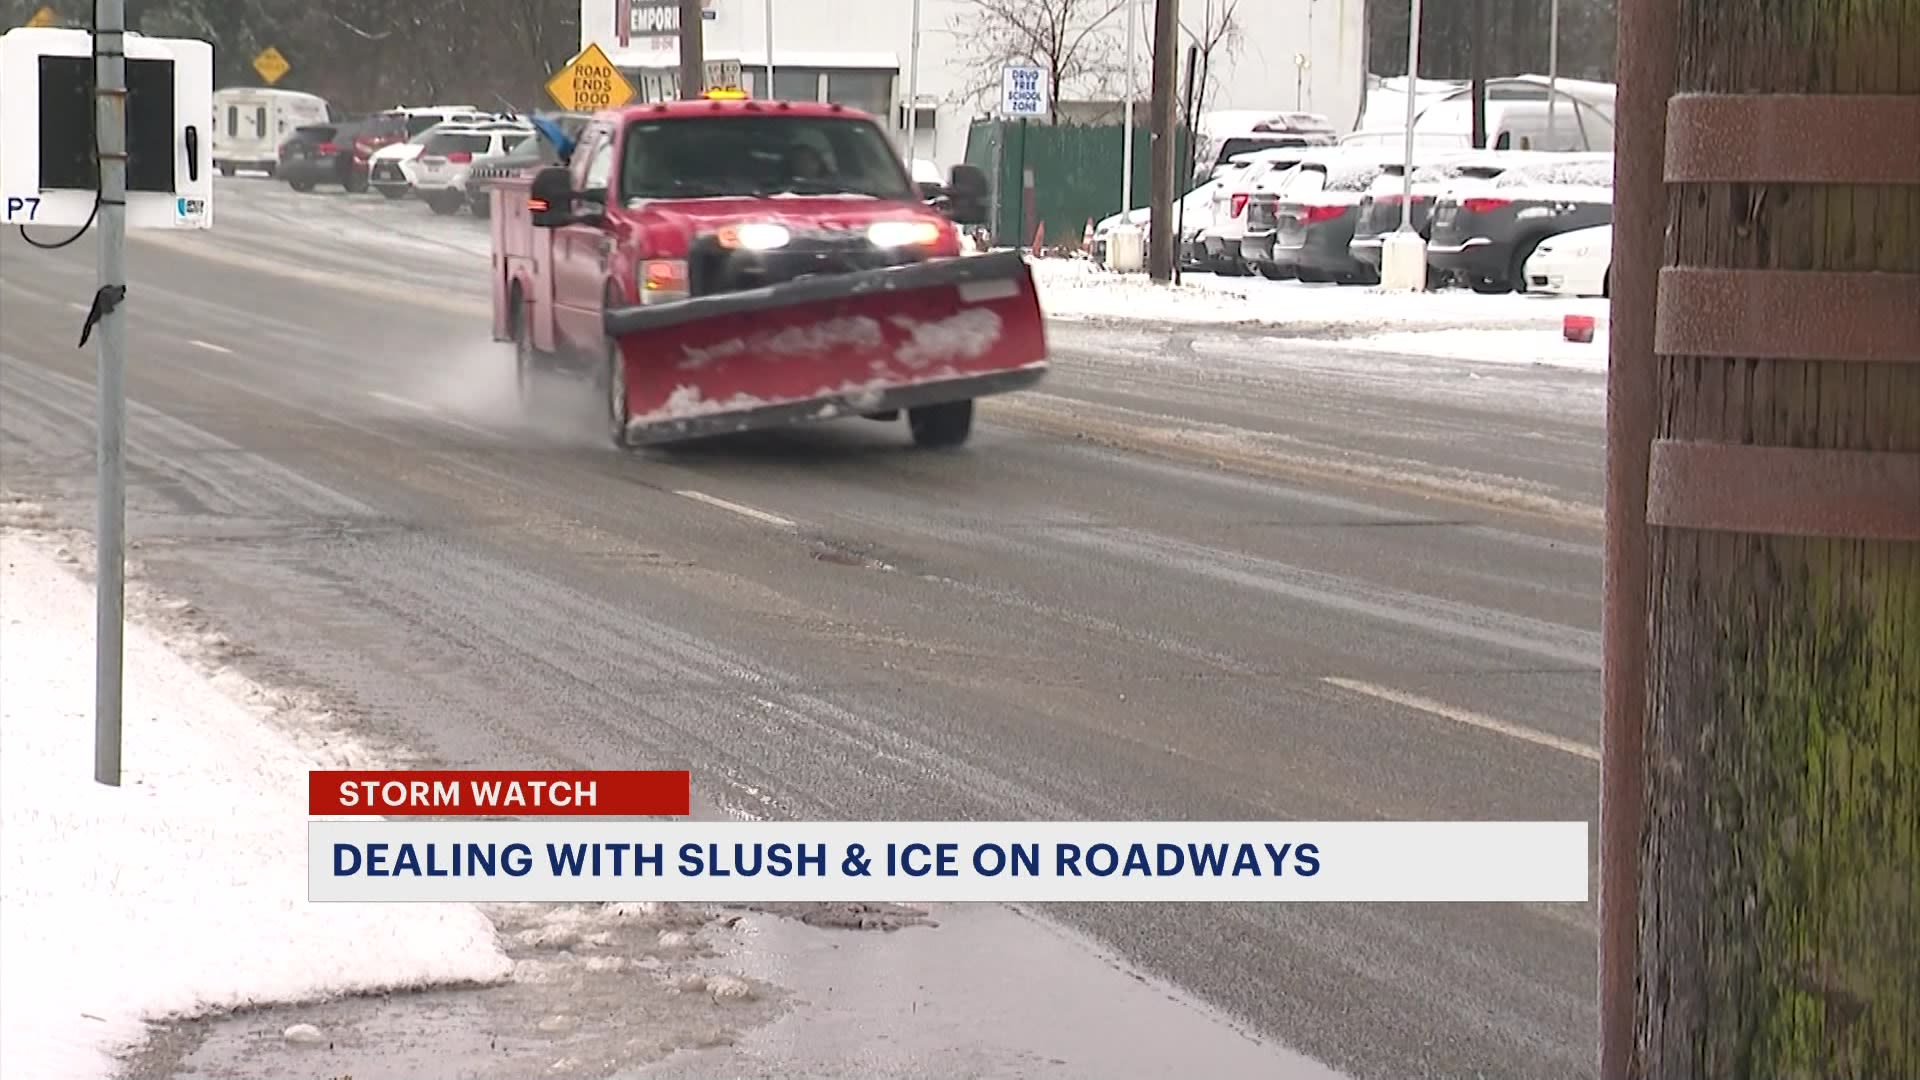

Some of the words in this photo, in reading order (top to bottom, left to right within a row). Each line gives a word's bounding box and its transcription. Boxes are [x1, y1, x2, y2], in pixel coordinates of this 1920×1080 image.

[575, 64, 611, 78] ROAD
[573, 77, 612, 92] ENDS
[1014, 81, 1036, 90] FREE
[575, 91, 610, 105] 1000
[1008, 91, 1041, 101] SCHOOL
[1012, 101, 1036, 112] ZONE
[7, 197, 40, 220] P7
